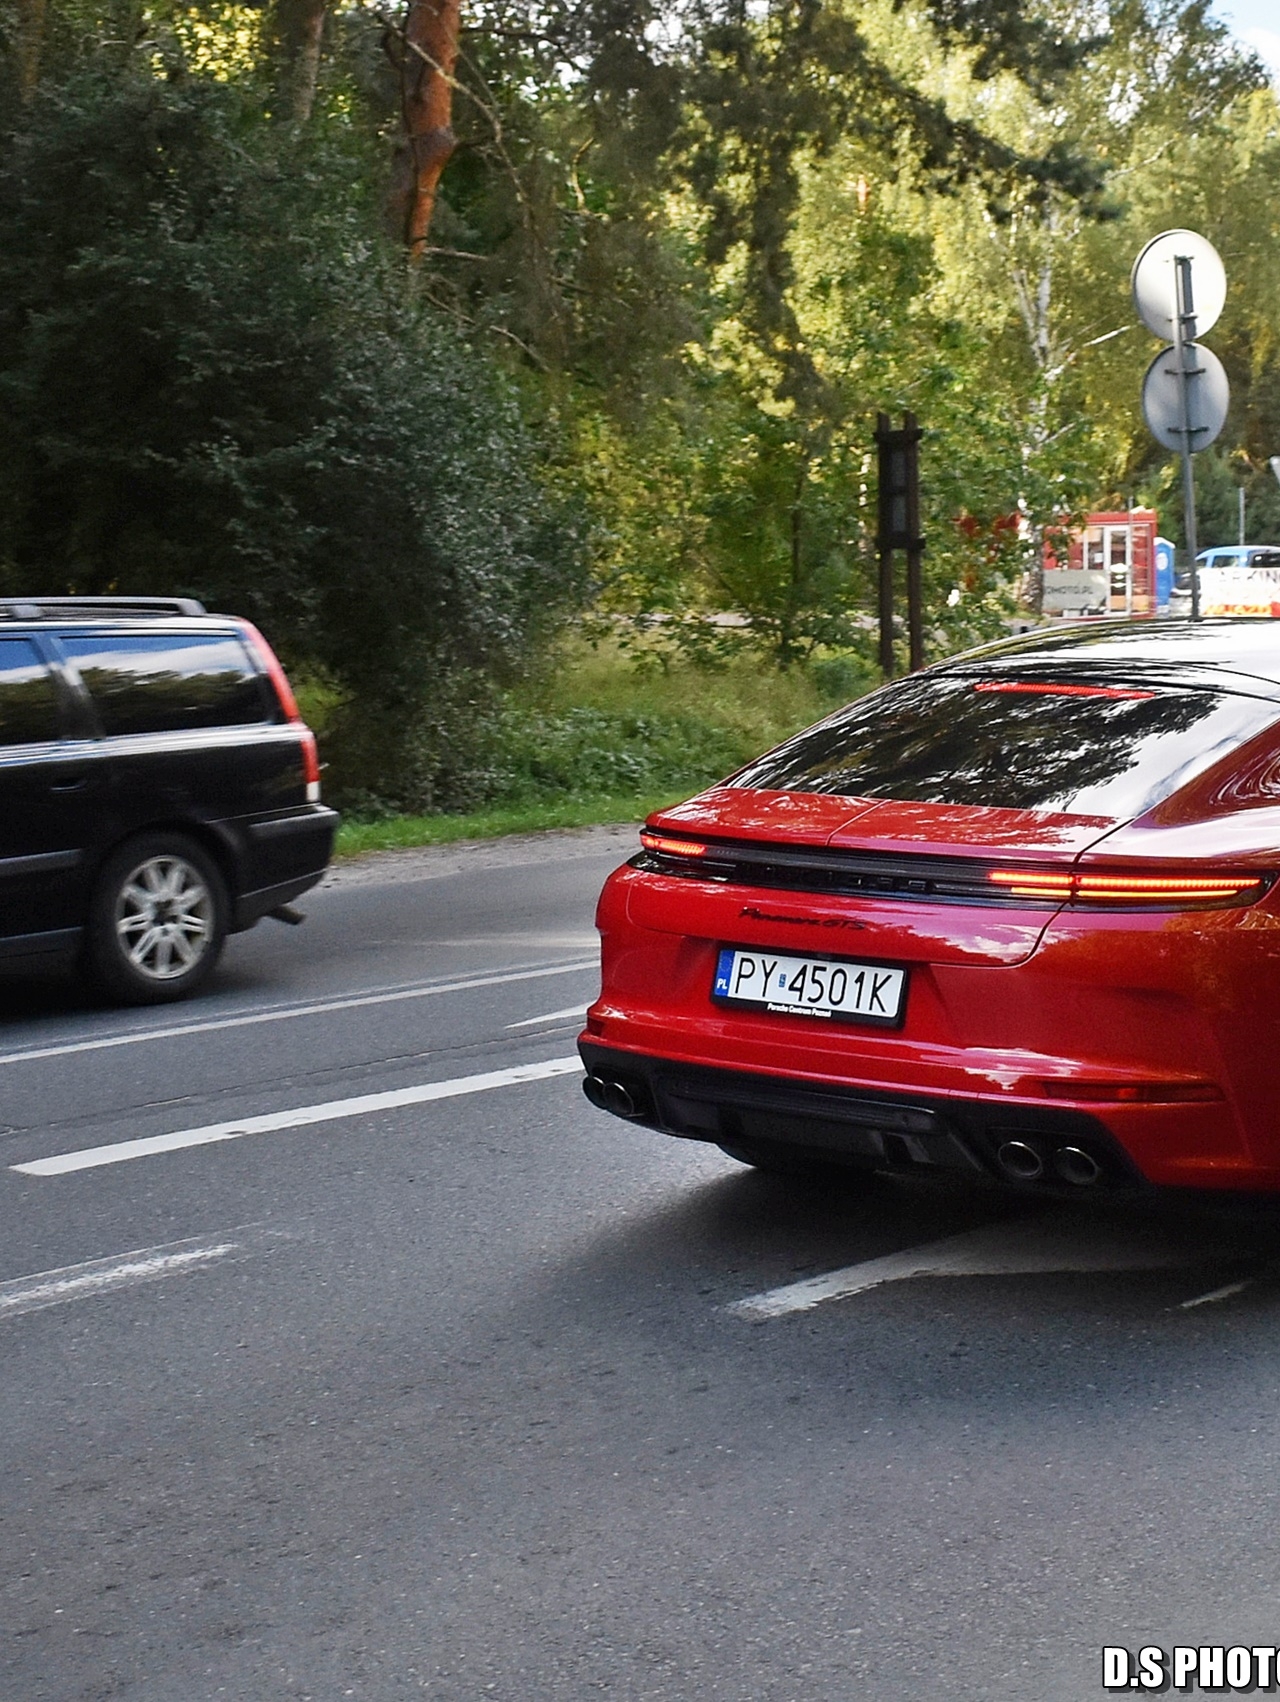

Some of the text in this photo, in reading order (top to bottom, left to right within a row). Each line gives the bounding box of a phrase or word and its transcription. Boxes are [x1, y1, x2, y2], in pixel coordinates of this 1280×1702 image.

[822, 918, 867, 930] GTS
[716, 978, 728, 990] PL
[734, 957, 893, 1013] PY 4501K
